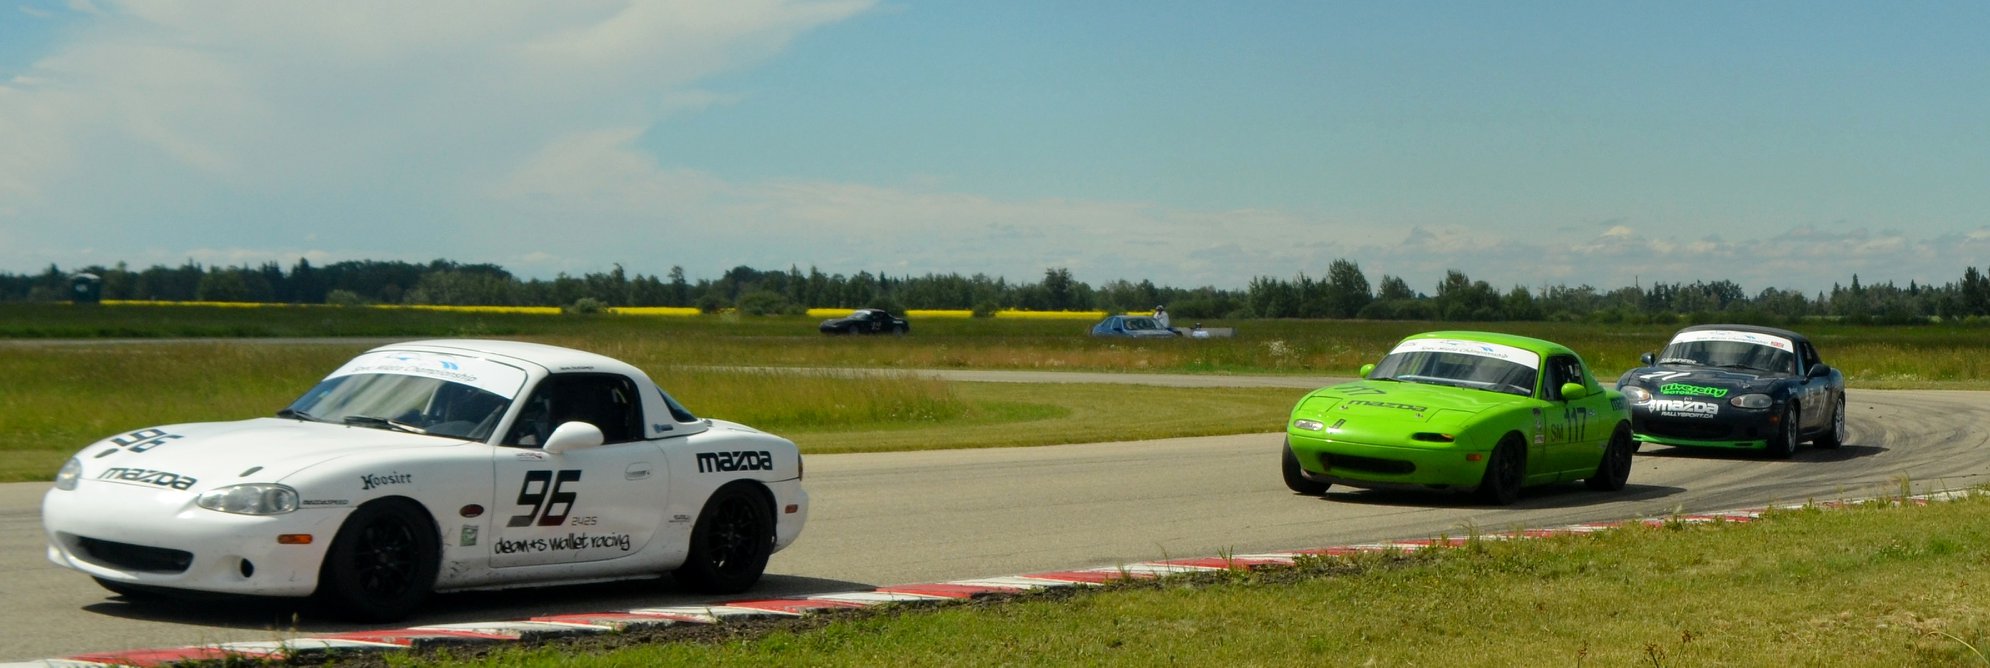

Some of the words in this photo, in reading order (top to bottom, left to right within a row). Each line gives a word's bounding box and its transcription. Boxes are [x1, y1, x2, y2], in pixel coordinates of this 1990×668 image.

[110, 428, 184, 453] 96
[506, 469, 582, 527] 96
[549, 532, 589, 551] wallet
[591, 532, 631, 551] racing
